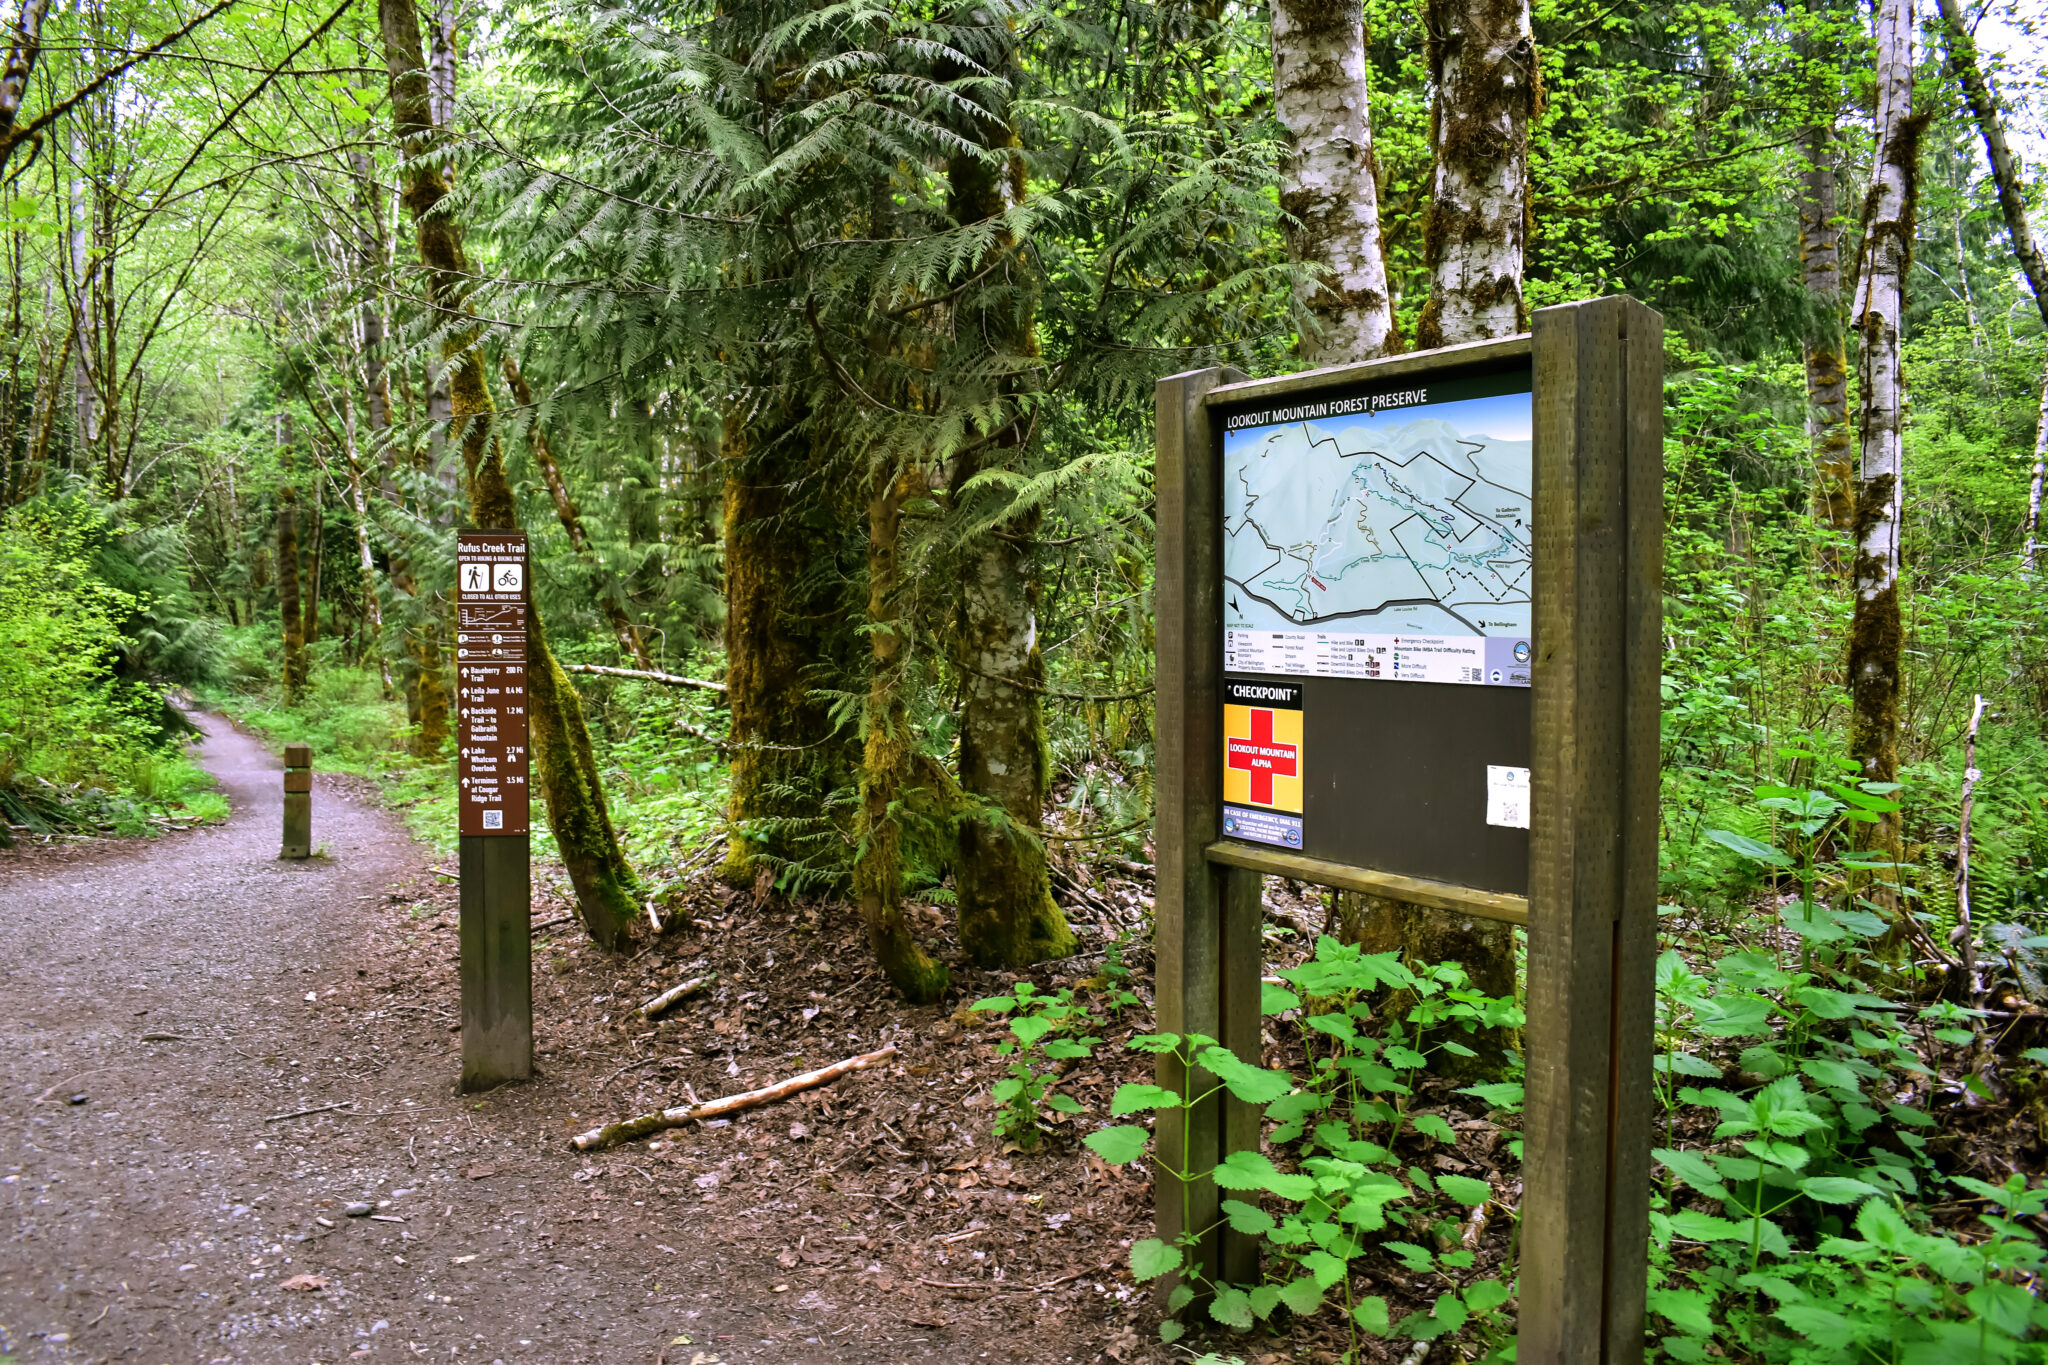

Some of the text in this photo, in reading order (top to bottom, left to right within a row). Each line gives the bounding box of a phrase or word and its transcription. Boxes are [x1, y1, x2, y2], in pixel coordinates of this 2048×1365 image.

[1227, 388, 1427, 429] LOOKOUT MOUNTAIN FOREST PRESERVE
[458, 543, 526, 553] Rufus Creek Trail
[506, 666, 516, 674] 200
[1233, 685, 1292, 701] CHECKPOINT
[506, 746, 515, 754] 2.7
[516, 746, 524, 754] Mi
[1230, 743, 1295, 759] LOOKOUT MOUNTAIN
[1251, 758, 1272, 768] ALPHA
[506, 776, 515, 784] 3.5
[478, 786, 499, 794] Cougar
[471, 795, 487, 803] Ridge
[1249, 812, 1279, 824] EMERGENCY,
